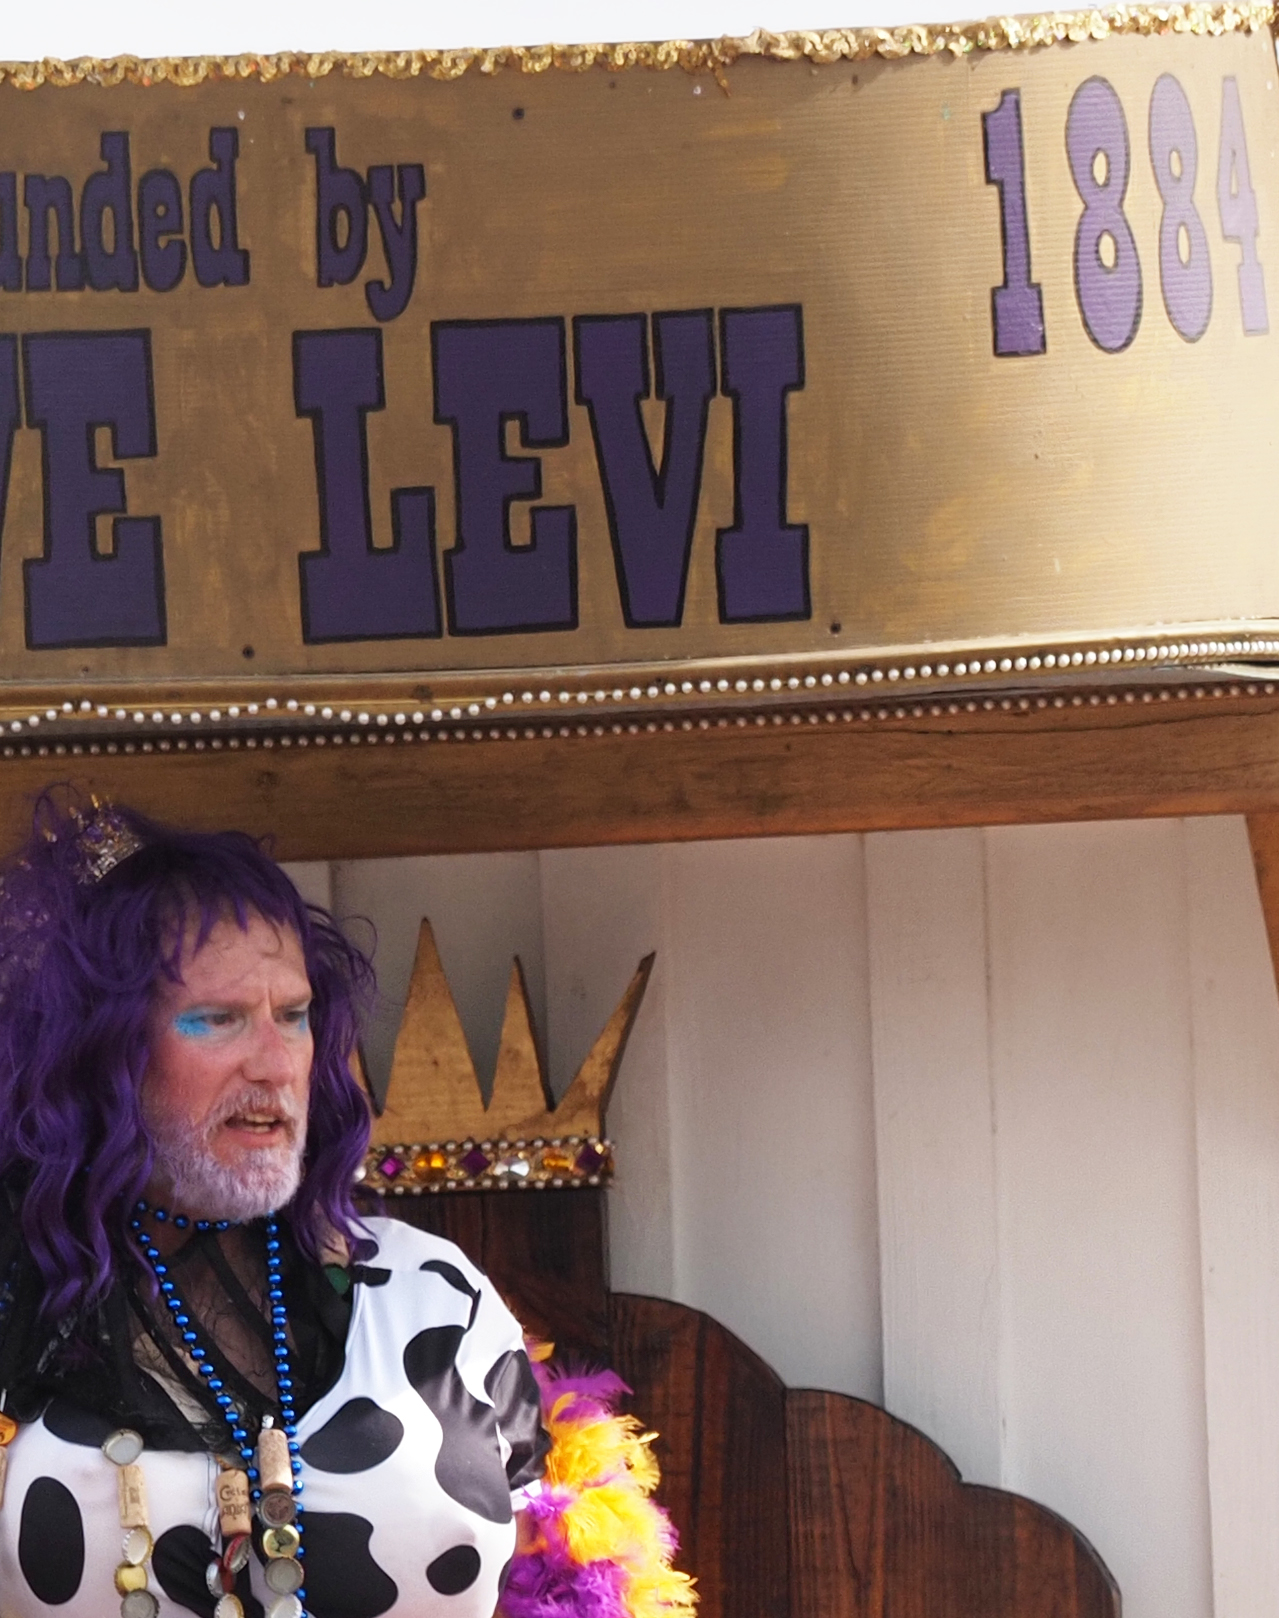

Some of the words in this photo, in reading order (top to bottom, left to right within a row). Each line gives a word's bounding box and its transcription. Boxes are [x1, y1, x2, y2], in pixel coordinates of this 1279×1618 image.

[305, 126, 425, 319] by
[980, 72, 1269, 358] 1884
[292, 304, 812, 643] LEVI
